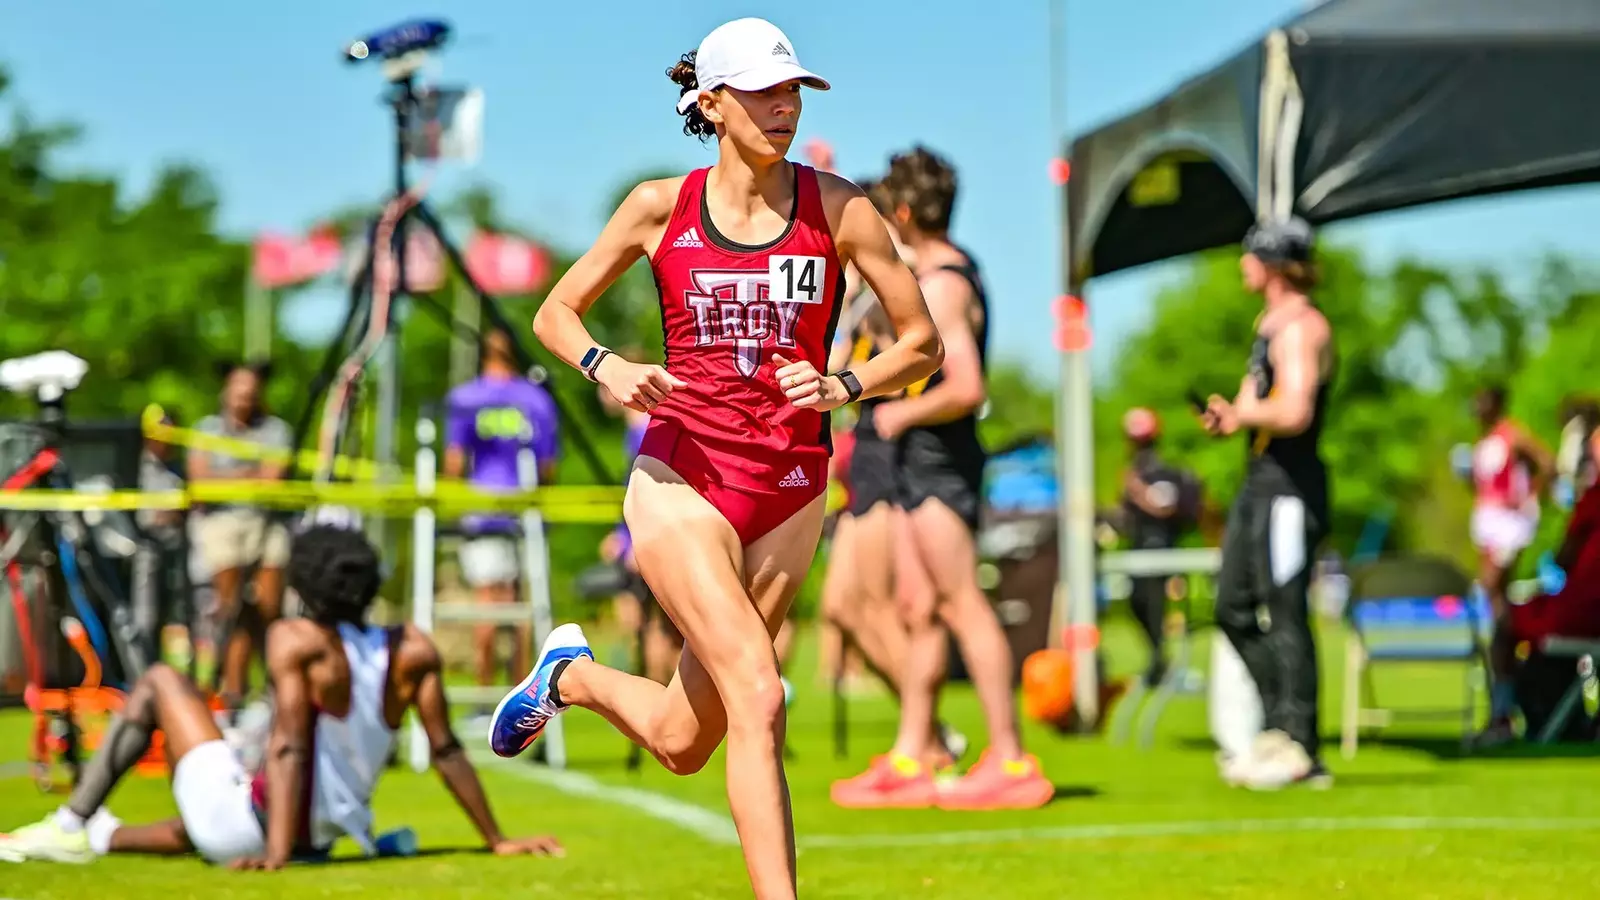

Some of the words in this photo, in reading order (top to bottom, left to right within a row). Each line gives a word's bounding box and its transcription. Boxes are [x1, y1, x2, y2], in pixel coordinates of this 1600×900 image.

[672, 240, 704, 248] adidas
[779, 258, 817, 300] 14
[778, 478, 810, 487] adidas
